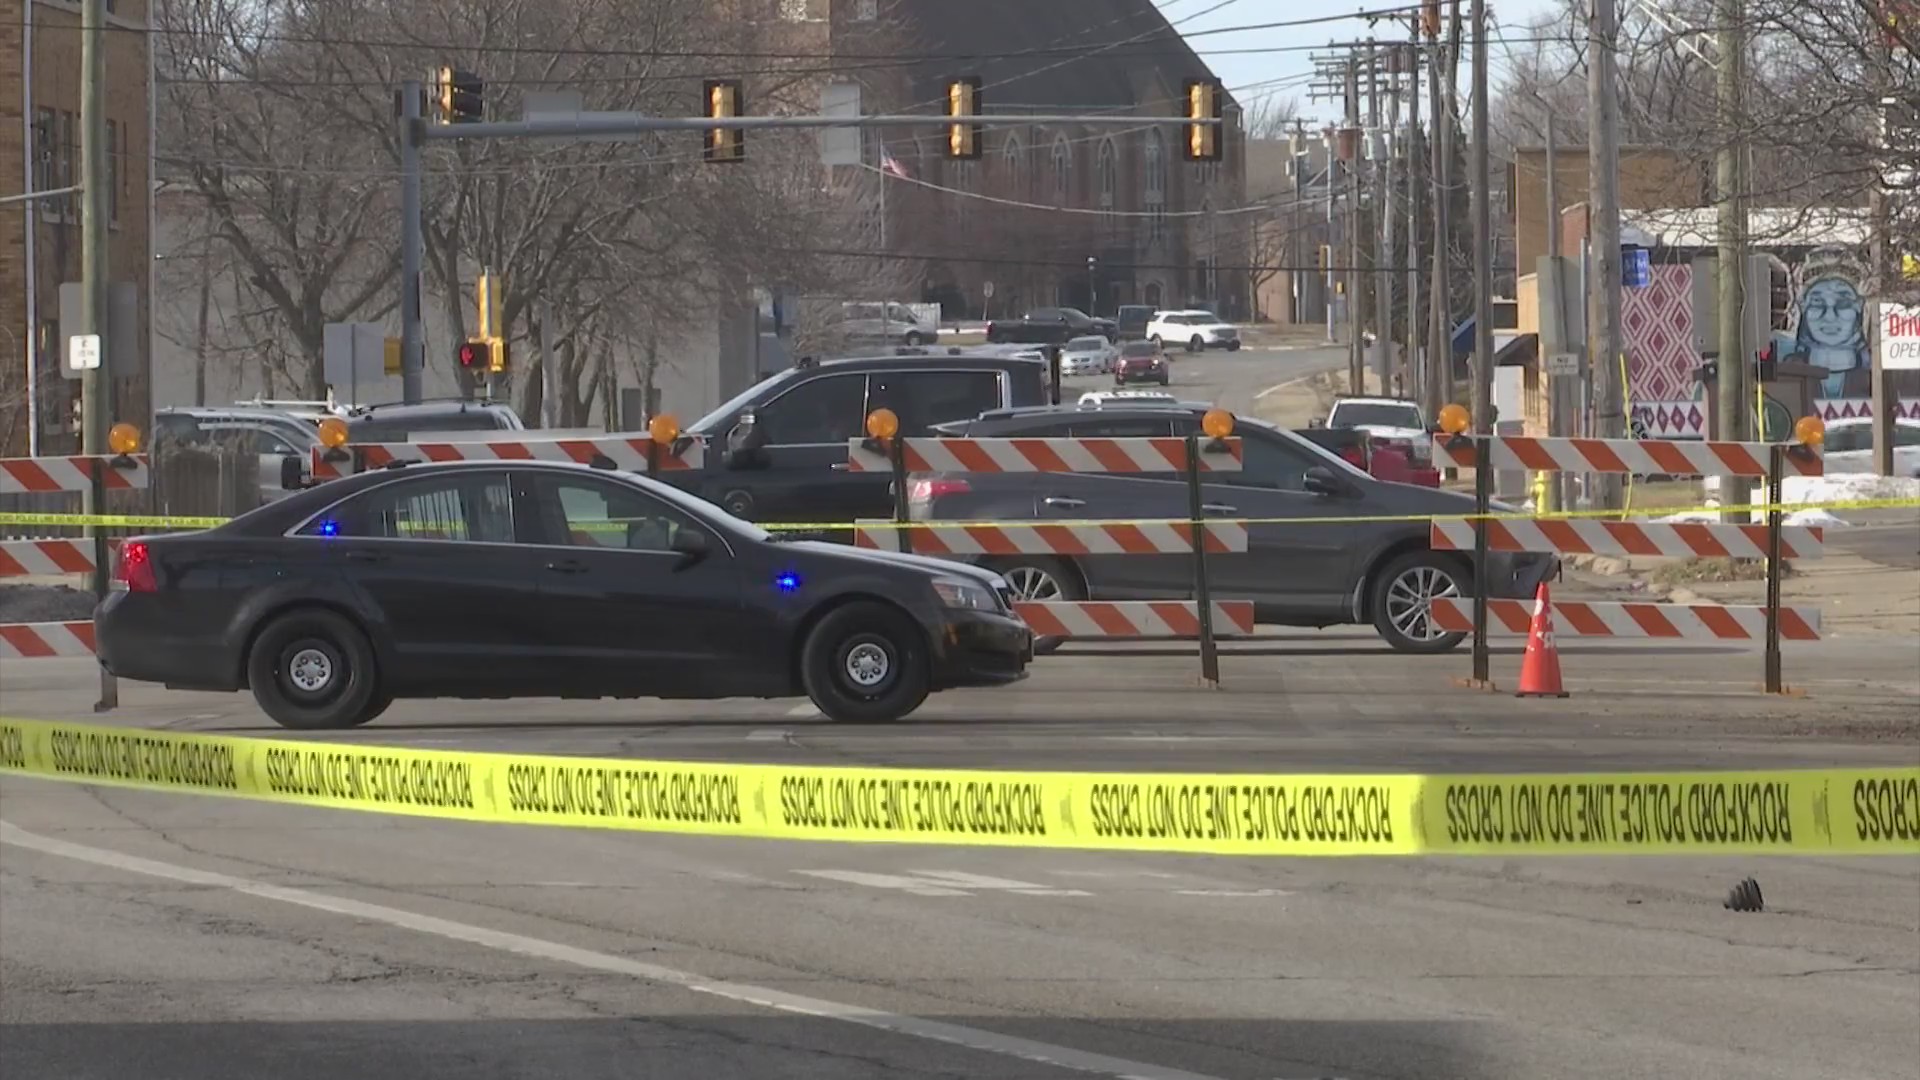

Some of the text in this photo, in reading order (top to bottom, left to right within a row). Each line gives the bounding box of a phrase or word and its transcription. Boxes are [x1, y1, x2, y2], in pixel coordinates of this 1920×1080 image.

[507, 764, 741, 824] ROCKFORD POLICE LINE DO NOT CROSS
[780, 776, 1046, 835] ROCKFORD POLICE LINE DO NOT CROSS
[1090, 784, 1393, 843] ROCKFORD POLICE LINE DO NOT CROSS
[1446, 783, 1792, 843] ROCKFORD POLICE LINE DO NOT CROSS
[1854, 778, 1920, 841] CROSS
